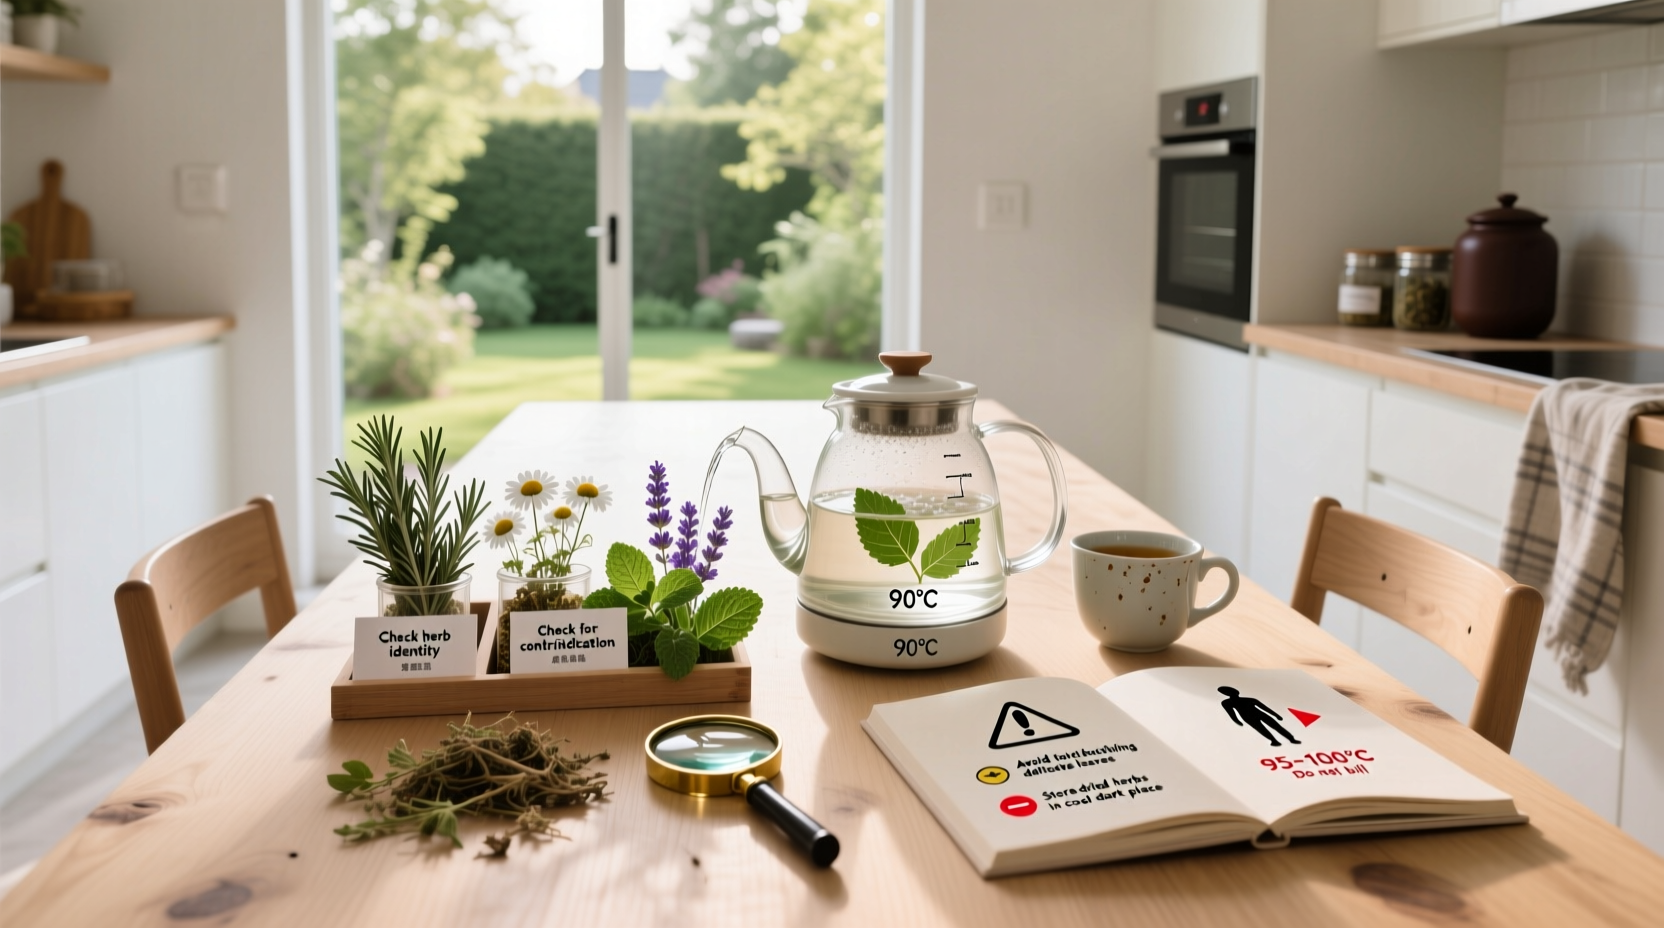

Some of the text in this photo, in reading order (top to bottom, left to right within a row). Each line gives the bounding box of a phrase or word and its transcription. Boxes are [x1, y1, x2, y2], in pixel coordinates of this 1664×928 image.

[889, 589, 938, 609] 90°C
[379, 629, 451, 643] Check herb
[538, 622, 598, 636] Check for
[389, 644, 440, 659] identity
[894, 638, 938, 657] 90°C
[1292, 770, 1315, 779] Do
